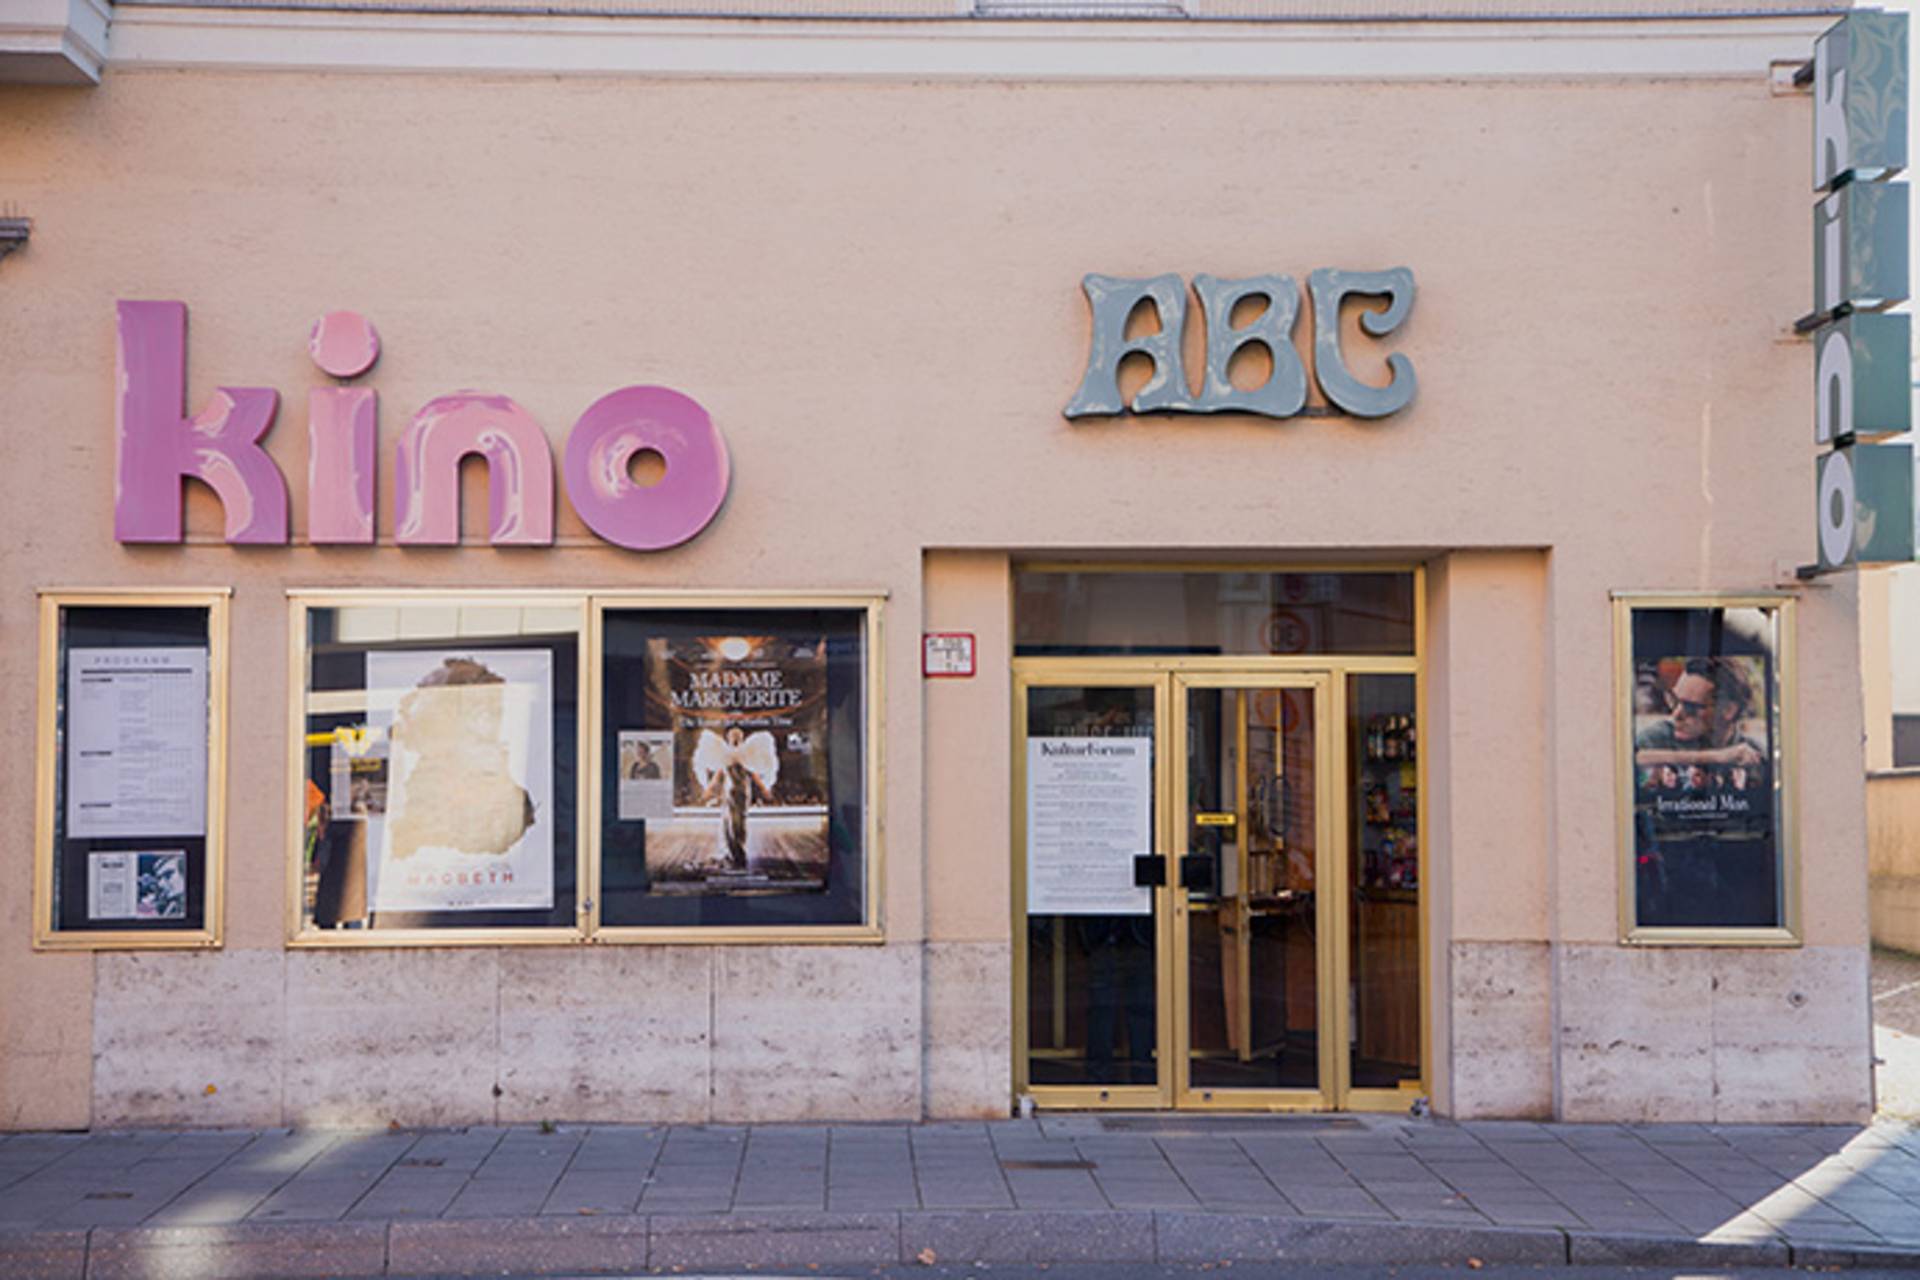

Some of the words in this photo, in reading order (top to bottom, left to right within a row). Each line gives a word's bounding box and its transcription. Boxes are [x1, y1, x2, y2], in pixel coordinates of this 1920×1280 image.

[1816, 38, 1855, 567] kino
[1064, 266, 1417, 420] ABC
[114, 300, 731, 552] kino
[688, 670, 783, 688] MADAME
[671, 689, 803, 708] MARGUERITE
[1657, 794, 1717, 811] Irrational
[1720, 794, 1749, 811] Man
[407, 871, 514, 886] MACBETH
